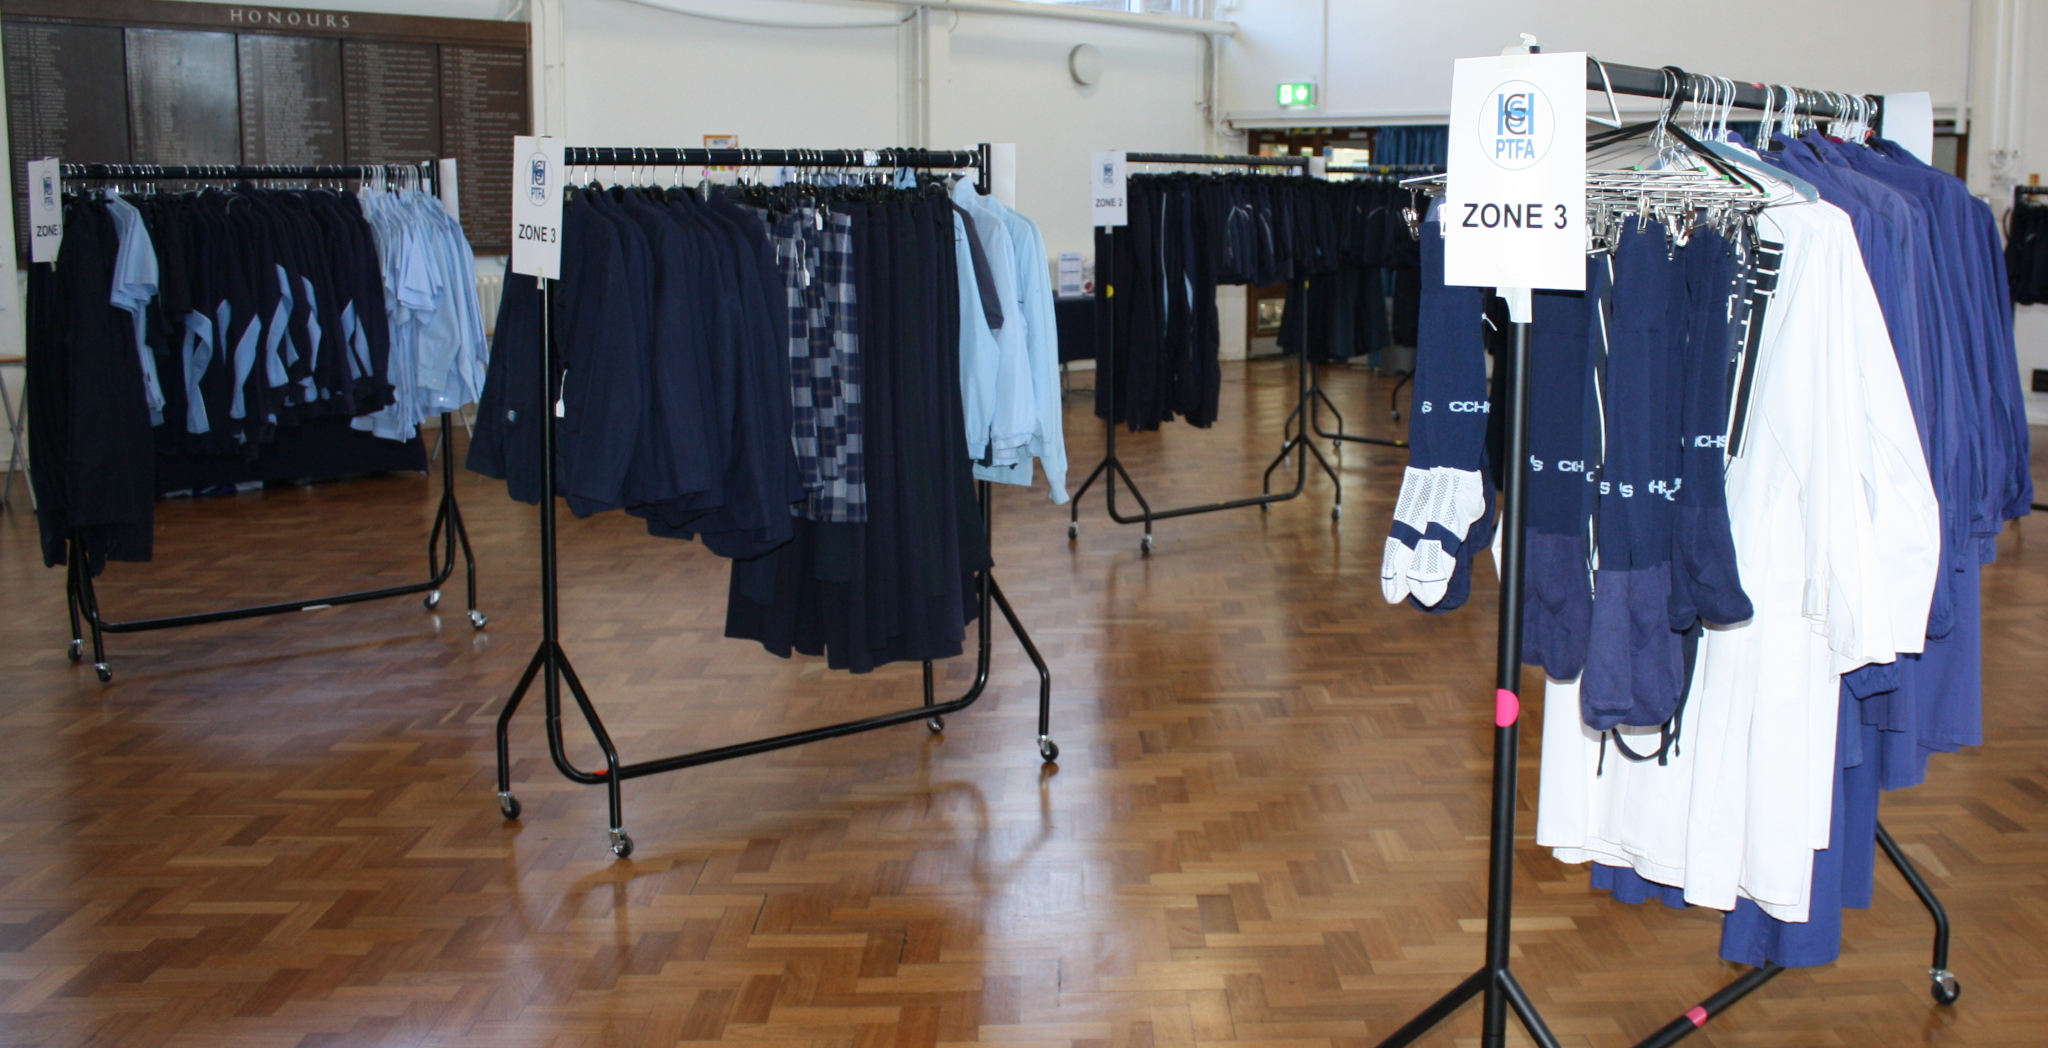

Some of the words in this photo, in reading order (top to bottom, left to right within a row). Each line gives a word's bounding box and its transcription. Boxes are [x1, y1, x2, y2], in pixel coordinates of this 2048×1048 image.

[230, 9, 350, 28] HONOURS
[1496, 138, 1536, 160] PTFA
[531, 187, 545, 200] PTFA
[1095, 198, 1116, 207] ZONE
[1462, 203, 1543, 229] ZONE
[1554, 204, 1568, 229] 3
[36, 224, 58, 237] ZONE
[518, 223, 548, 243] ZONE
[551, 227, 556, 244] 3
